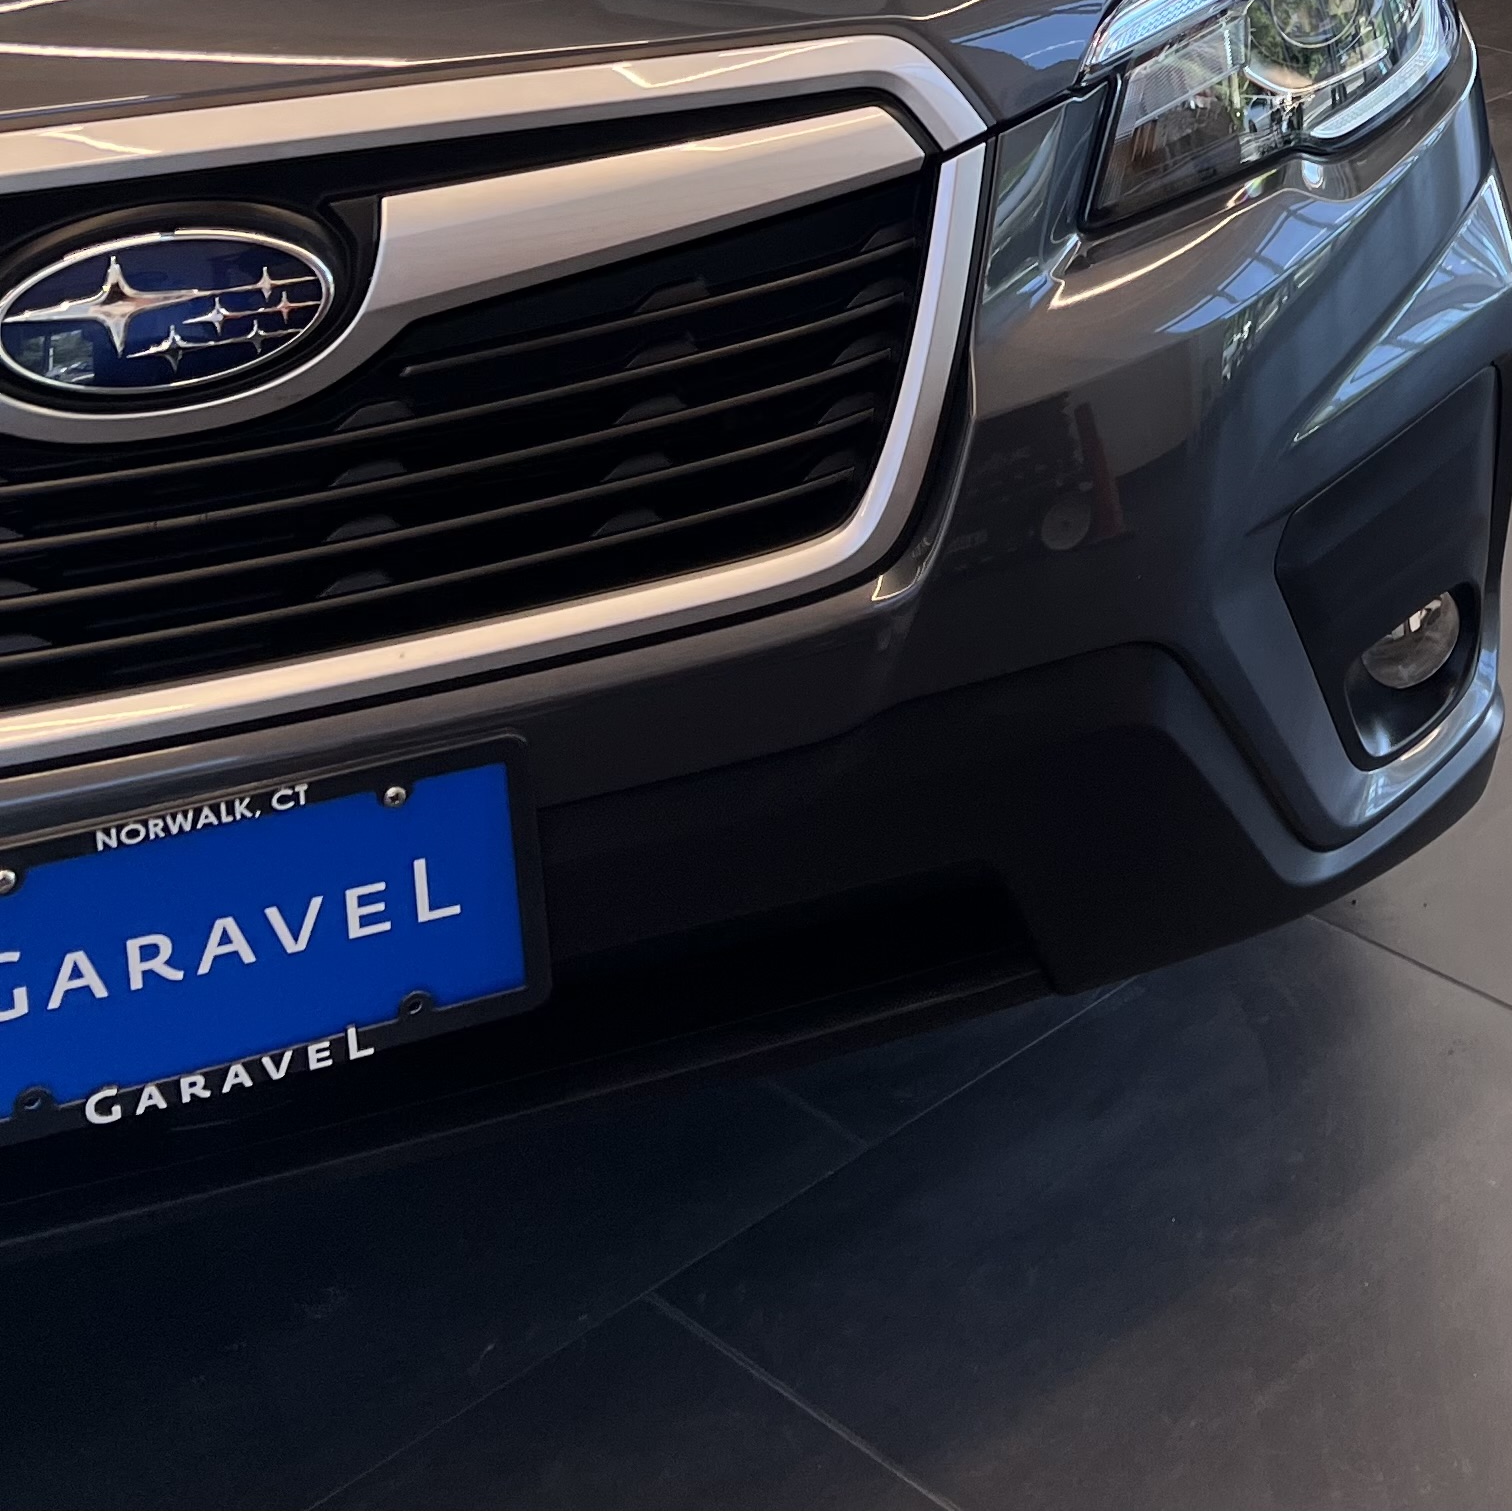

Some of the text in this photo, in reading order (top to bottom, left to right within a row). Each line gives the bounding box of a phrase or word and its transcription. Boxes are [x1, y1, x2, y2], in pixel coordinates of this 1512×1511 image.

[95, 784, 310, 852] NORWALK, CT
[84, 1024, 376, 1125] GARAVEL
